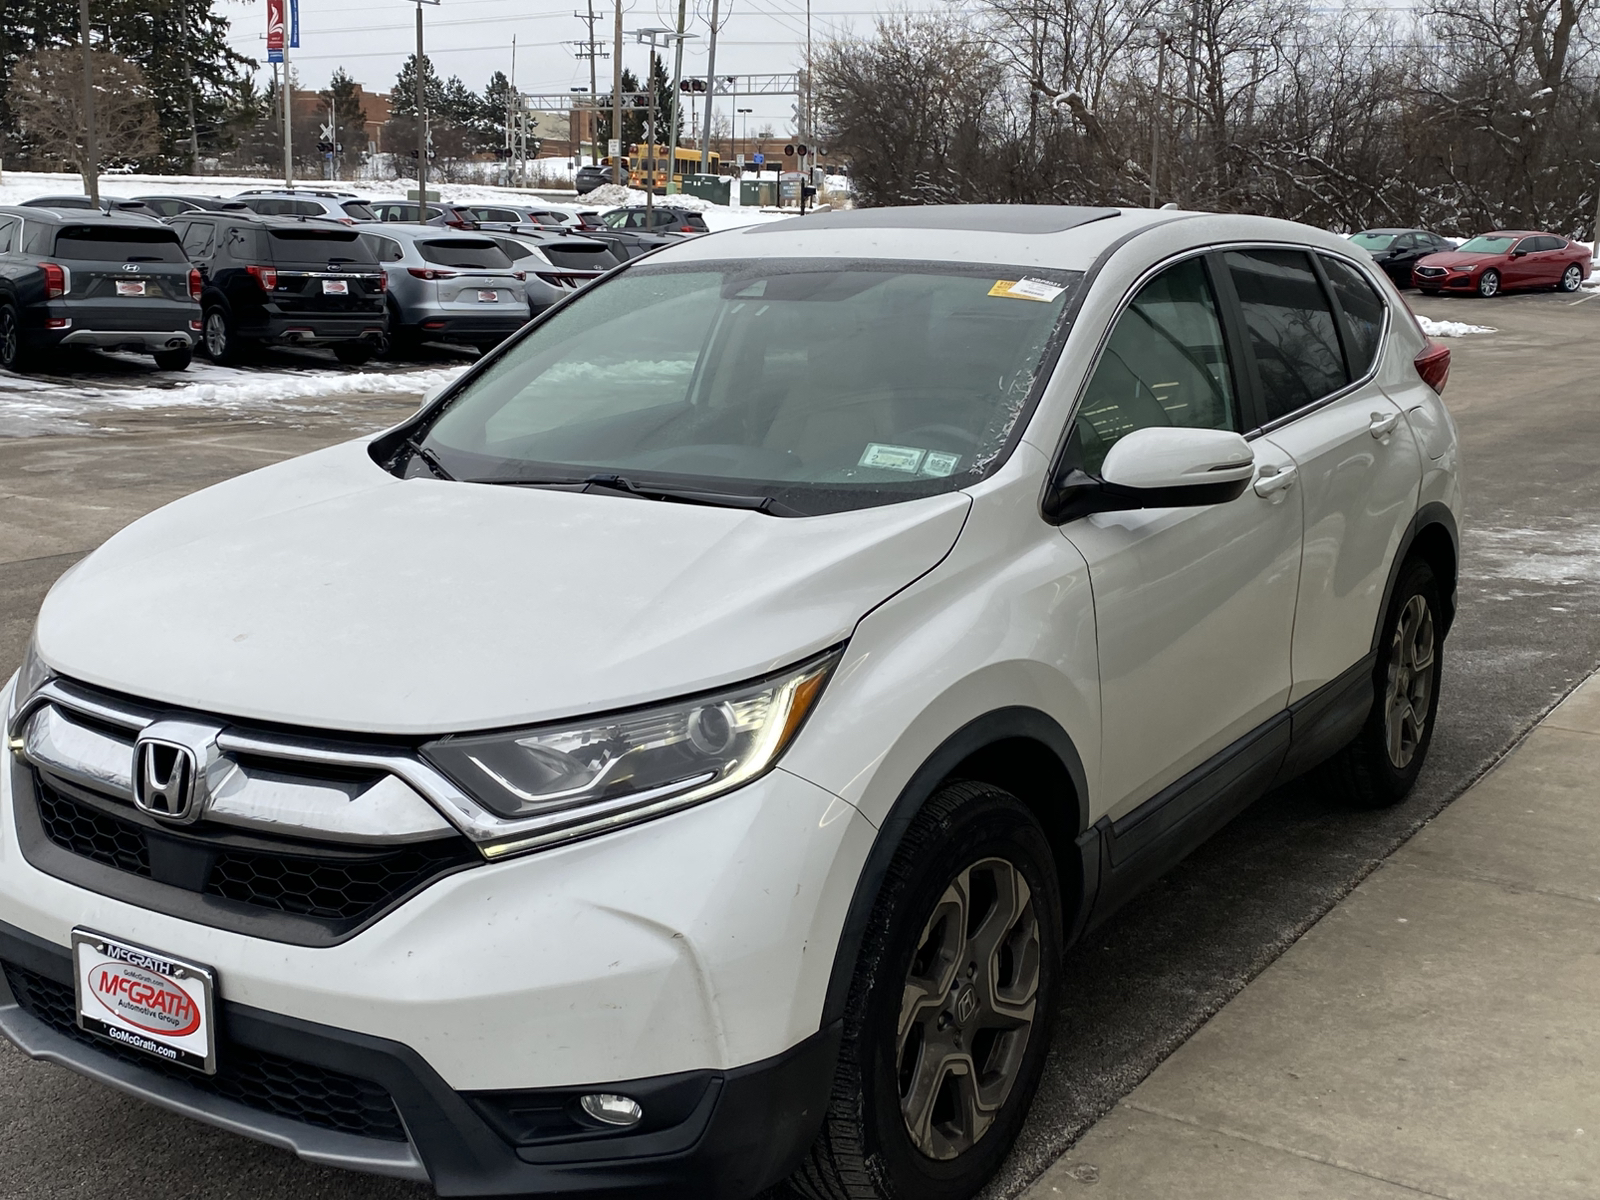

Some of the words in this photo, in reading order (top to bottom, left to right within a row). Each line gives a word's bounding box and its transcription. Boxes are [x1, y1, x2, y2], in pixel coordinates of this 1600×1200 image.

[107, 945, 170, 975] McGRATH
[123, 969, 164, 987] GoMcGrath.com
[99, 970, 191, 1021] McGRATH
[118, 999, 156, 1019] Automotive
[158, 1012, 180, 1027] Group
[109, 1027, 177, 1059] GoMcGrath.com
